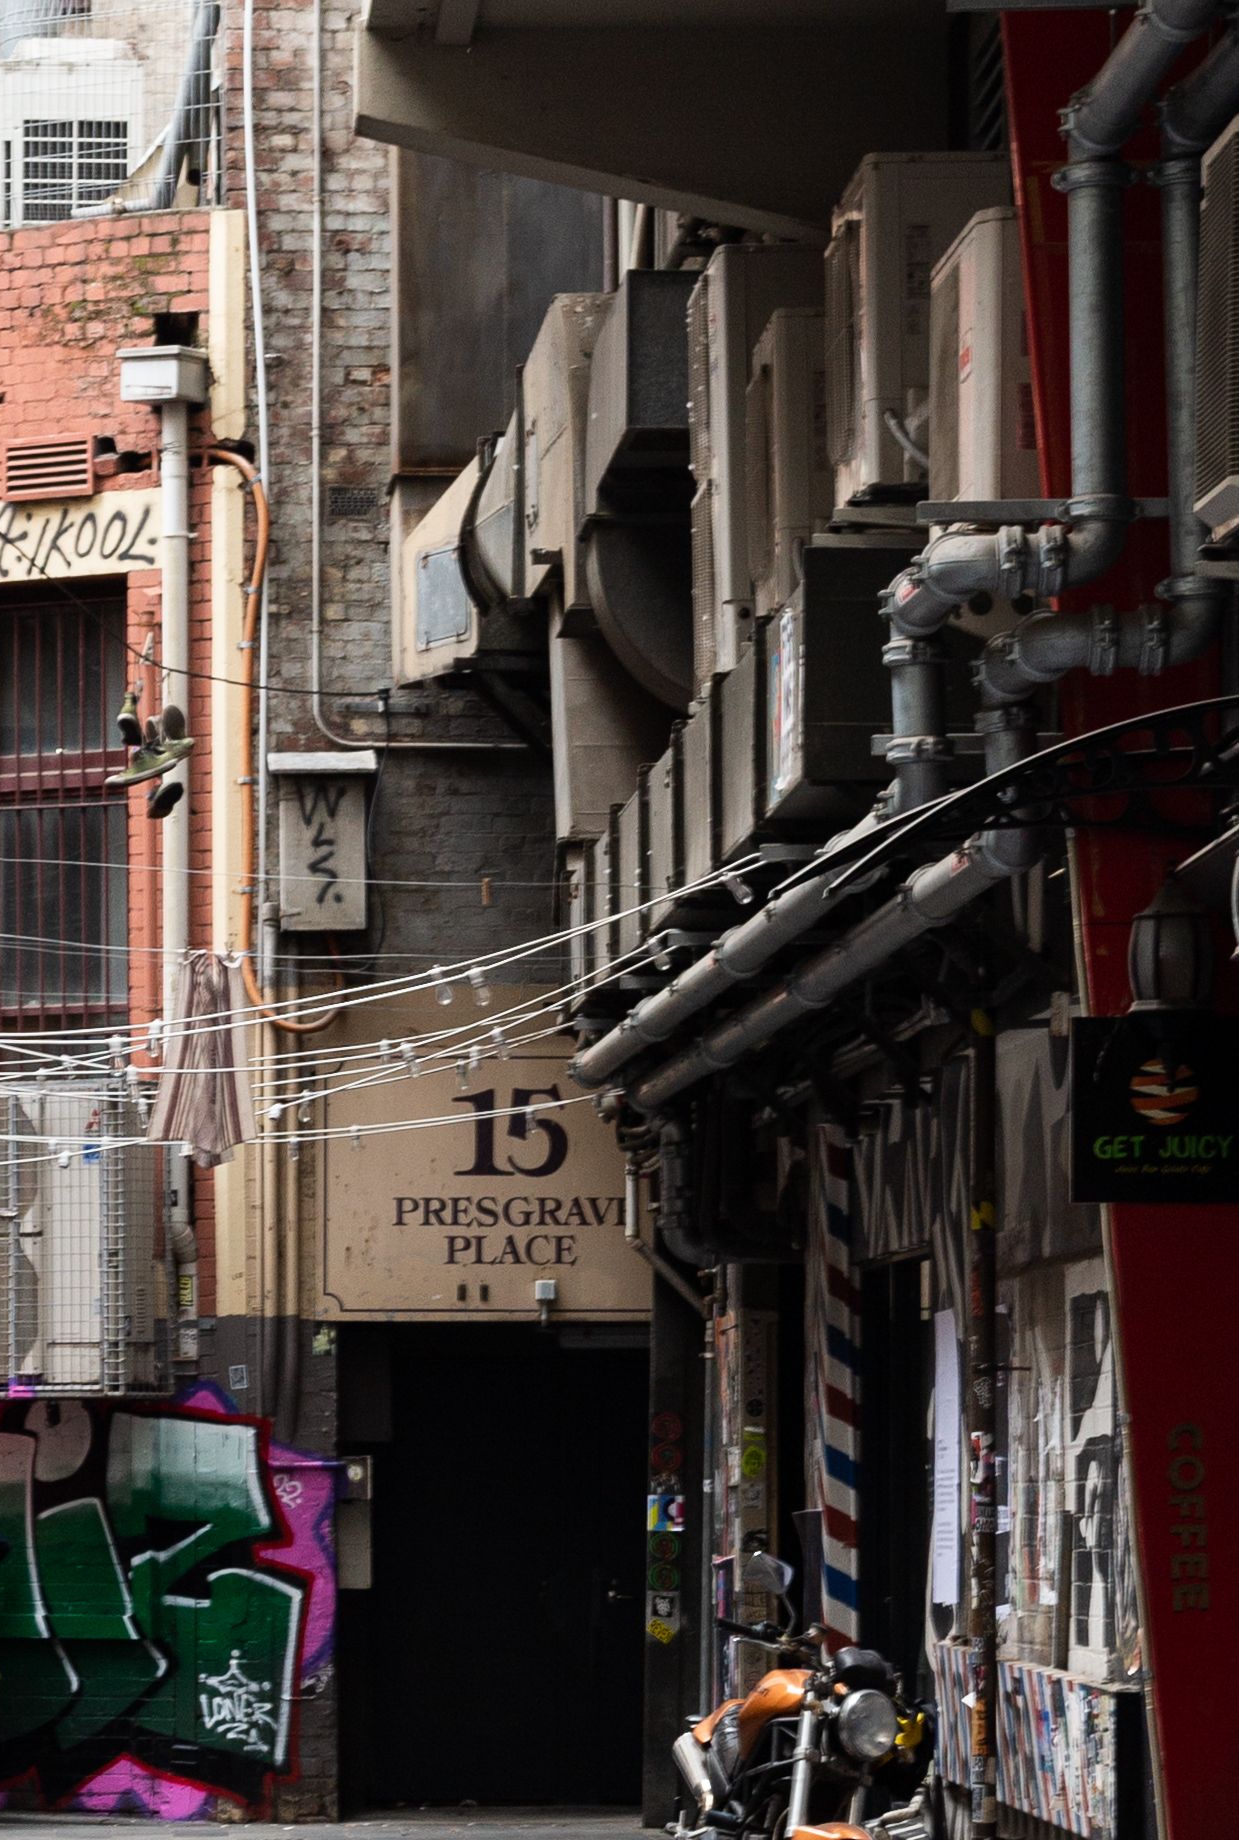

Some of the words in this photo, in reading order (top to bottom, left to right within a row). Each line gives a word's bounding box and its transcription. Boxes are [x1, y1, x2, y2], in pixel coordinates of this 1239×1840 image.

[451, 1083, 568, 1178] 15
[1093, 1136, 1145, 1160] GET
[1159, 1135, 1233, 1159] JUICY
[443, 1234, 579, 1266] PLACE
[1166, 1422, 1210, 1612] COFFEE
